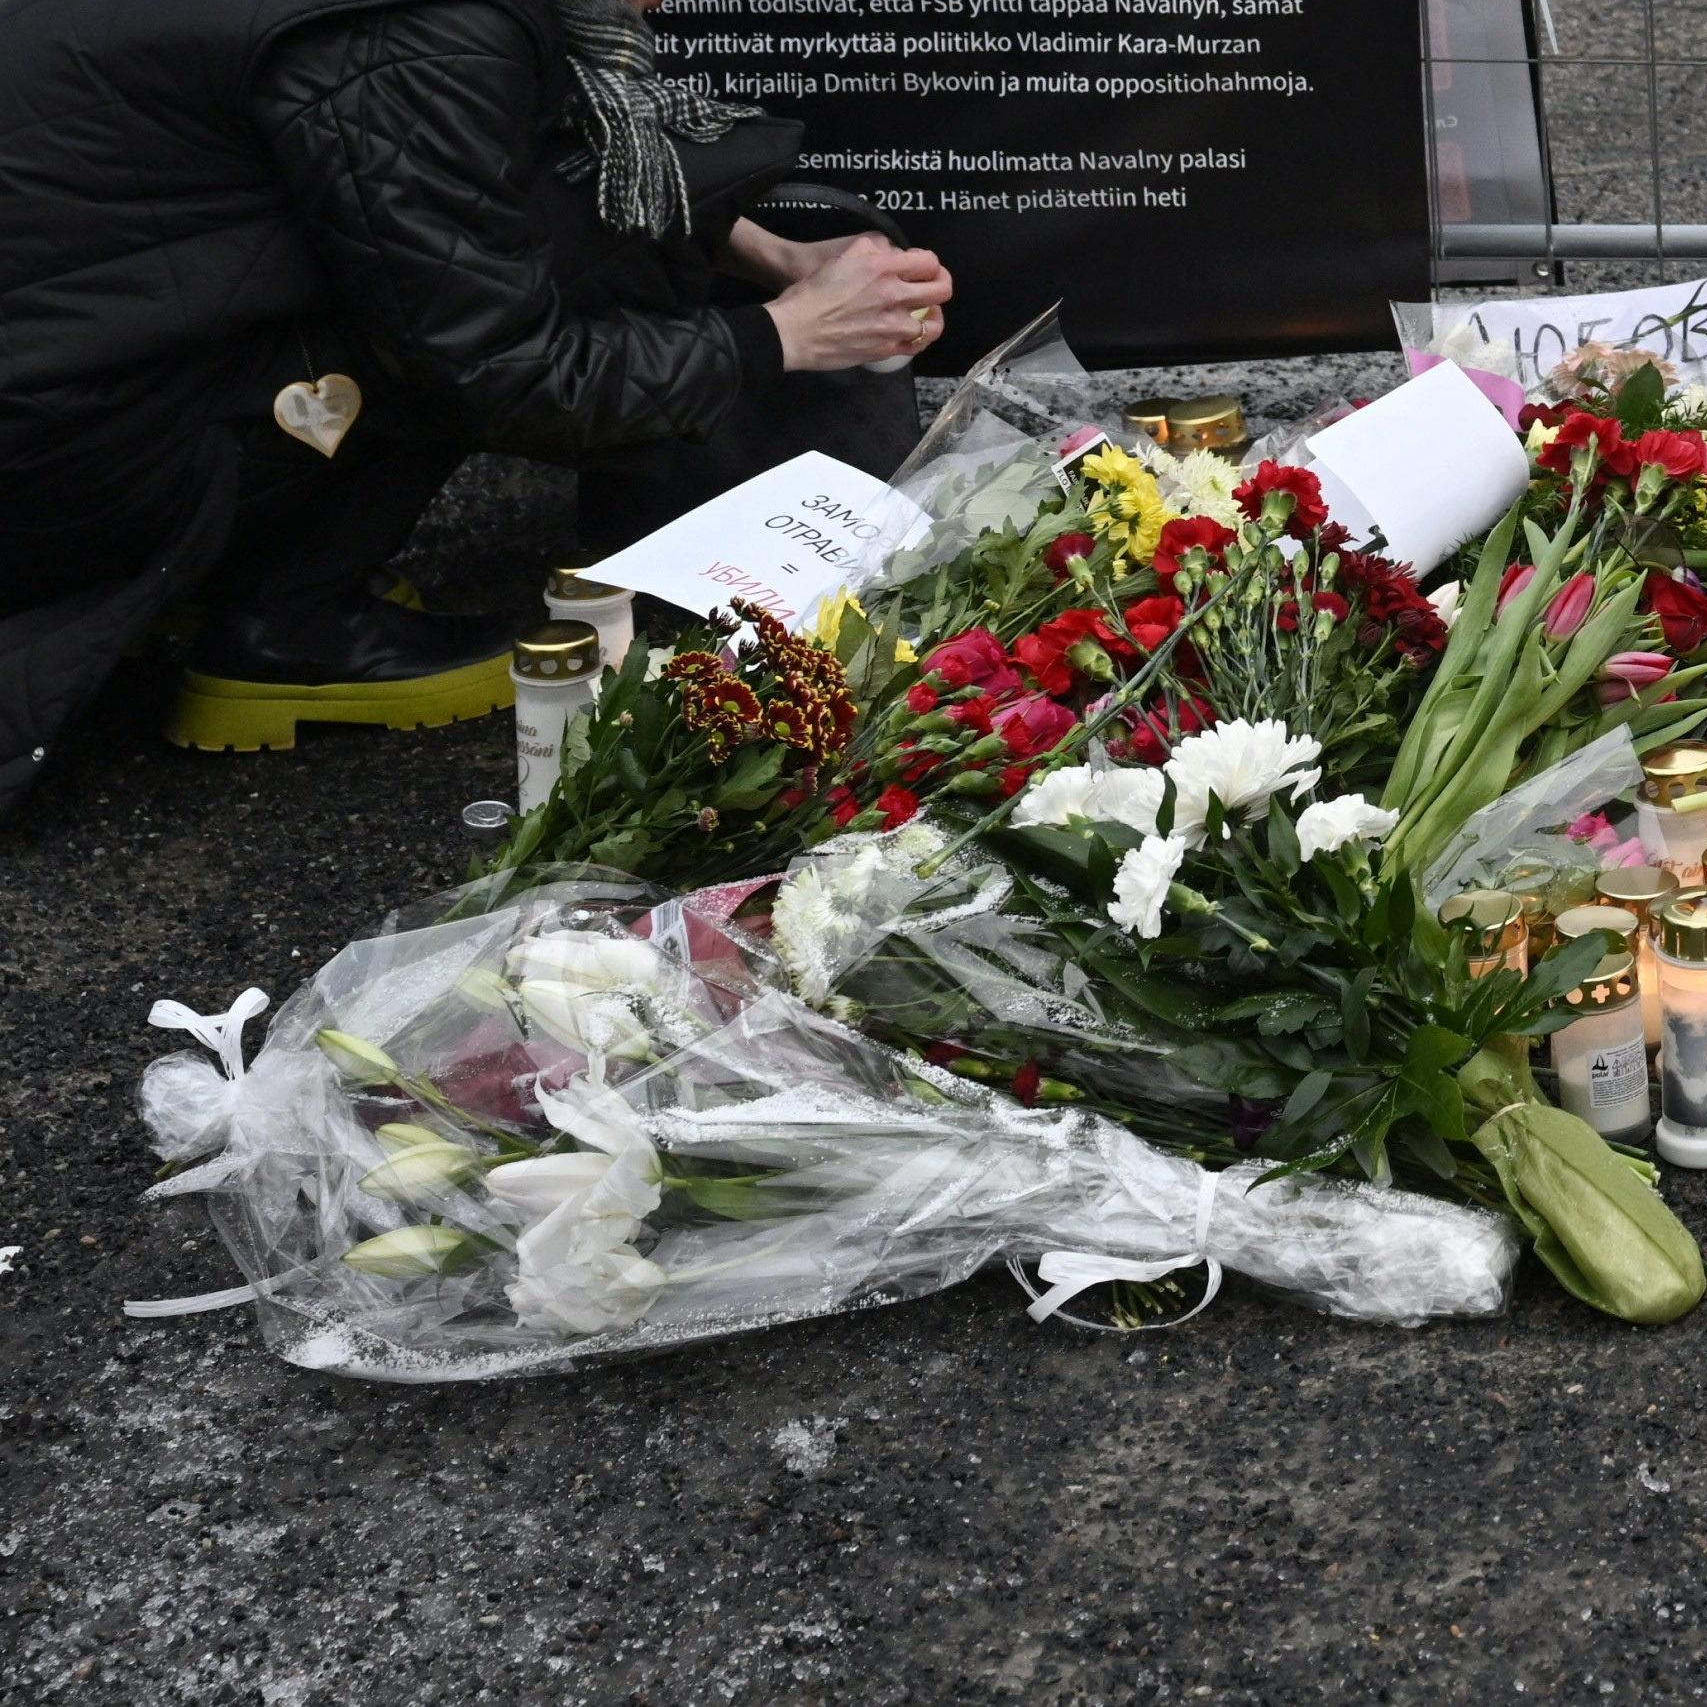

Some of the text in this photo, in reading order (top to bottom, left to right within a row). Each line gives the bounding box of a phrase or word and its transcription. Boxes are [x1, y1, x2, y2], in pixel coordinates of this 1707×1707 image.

[796, 147, 1246, 174] semisriskistä huolimatta Navalny palasi
[874, 189, 934, 211] 2021.
[940, 190, 1011, 211] Hänet
[1016, 187, 1137, 214] pidätettiin
[1143, 186, 1187, 208] heti
[697, 560, 797, 622] УБИЛИ
